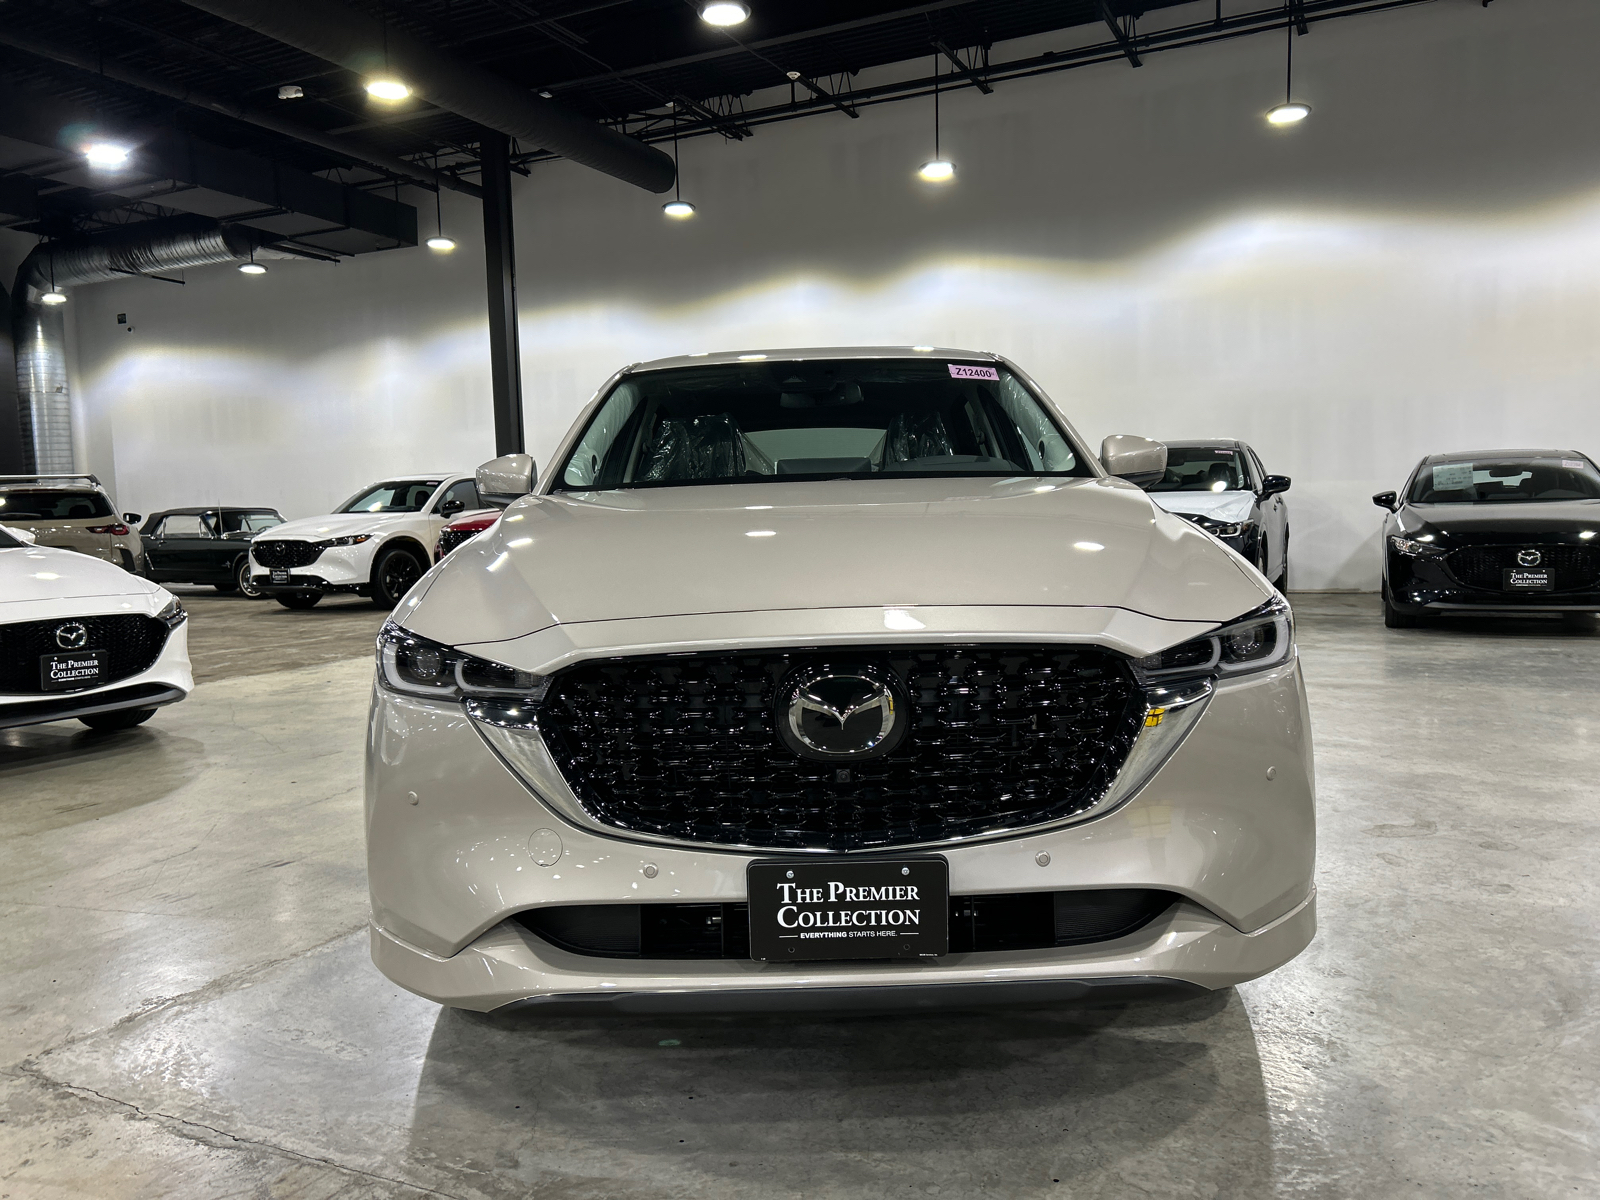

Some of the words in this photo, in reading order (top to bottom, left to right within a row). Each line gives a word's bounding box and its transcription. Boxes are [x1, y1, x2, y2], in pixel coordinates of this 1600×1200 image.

[955, 367, 992, 378] Z12400
[50, 661, 67, 670] THE
[67, 659, 99, 668] PREMIER
[50, 667, 99, 679] COLLECTION
[776, 882, 824, 904] THE
[827, 881, 921, 903] PREMIER
[776, 905, 921, 928] COLLECTION
[800, 931, 848, 939] EVERYTHING
[848, 930, 876, 938] STARTS
